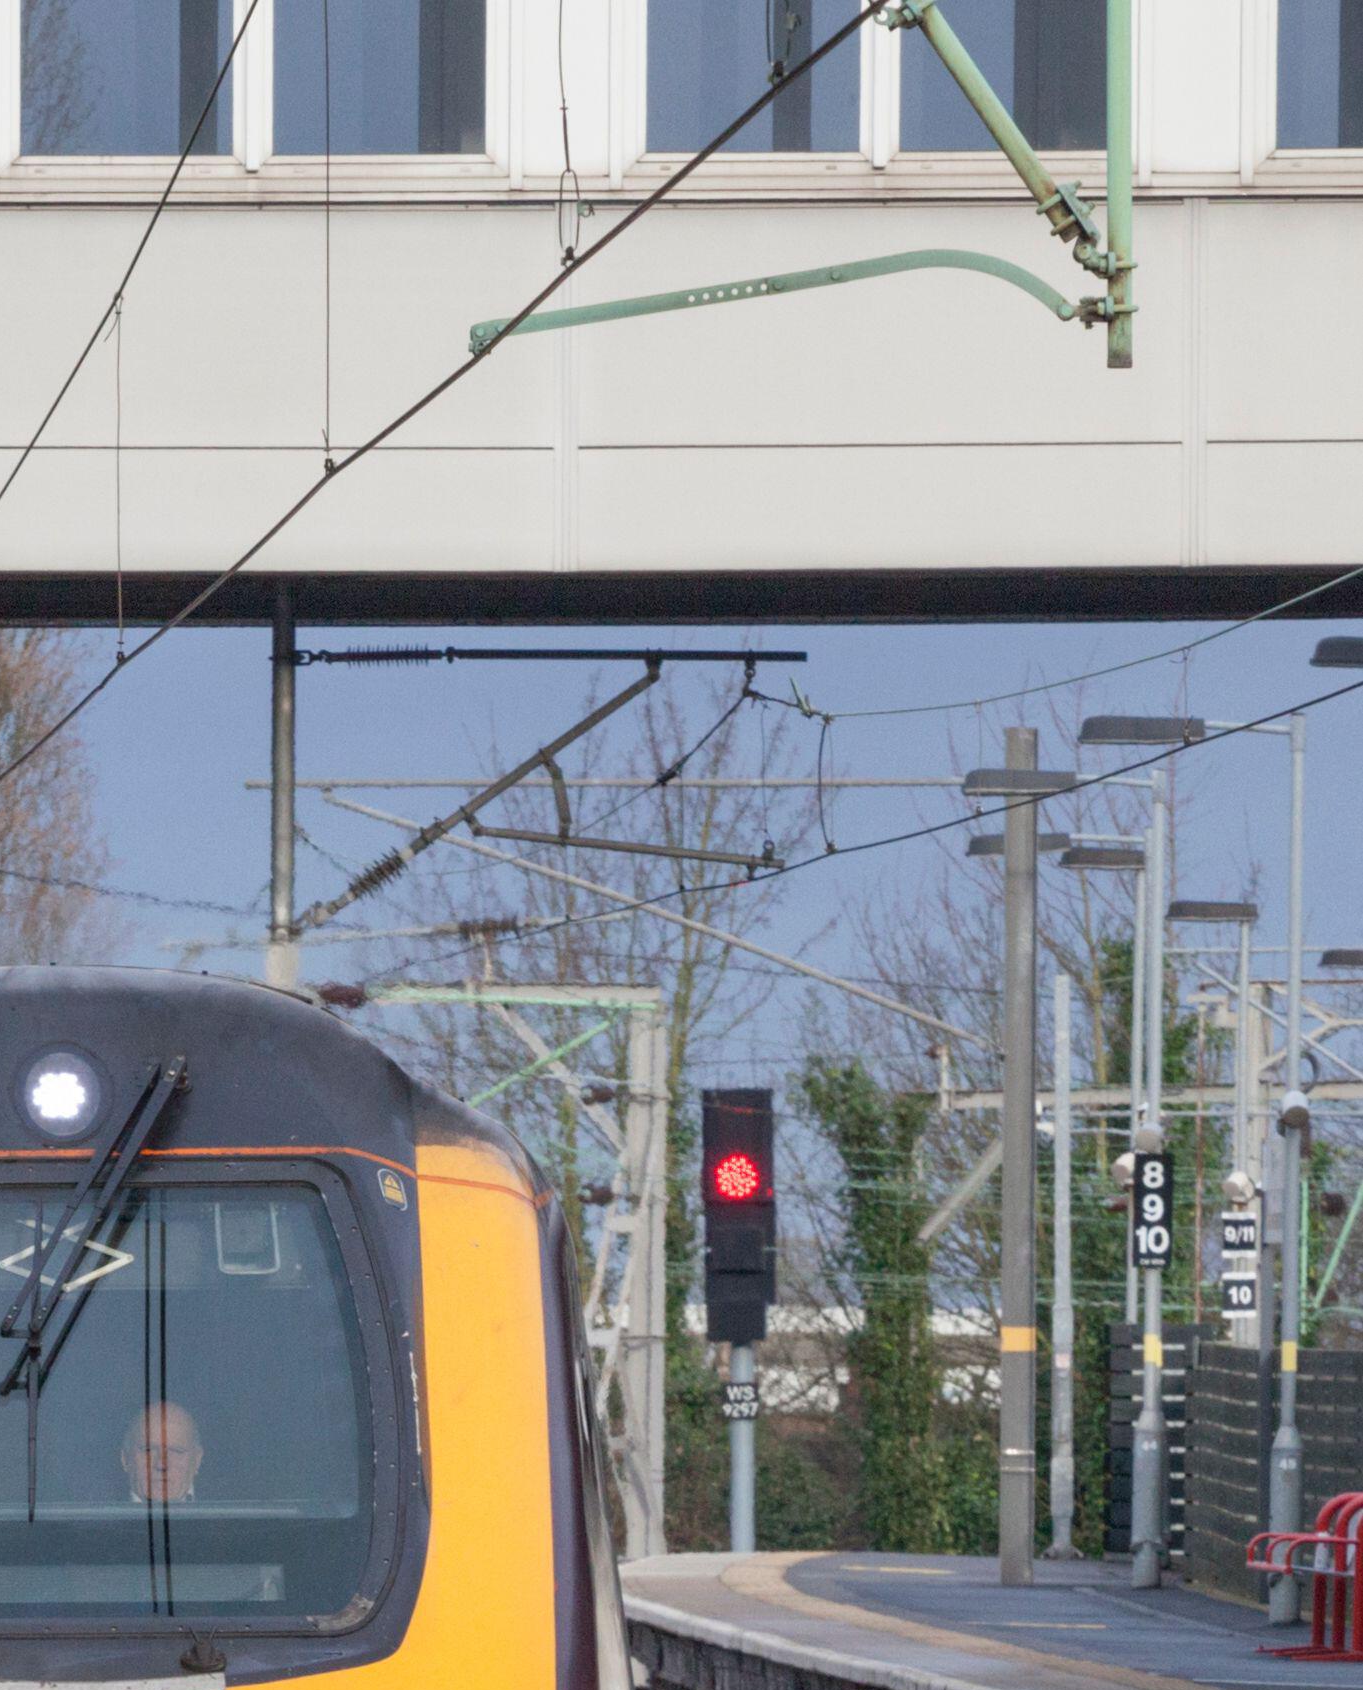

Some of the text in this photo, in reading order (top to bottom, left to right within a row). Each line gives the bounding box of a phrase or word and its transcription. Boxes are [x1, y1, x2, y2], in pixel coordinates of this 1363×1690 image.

[1142, 1160, 1165, 1189] 8
[1142, 1193, 1165, 1222] 9
[1135, 1225, 1170, 1255] 10
[1224, 1226, 1255, 1245] 9/11
[1228, 1286, 1252, 1305] 10
